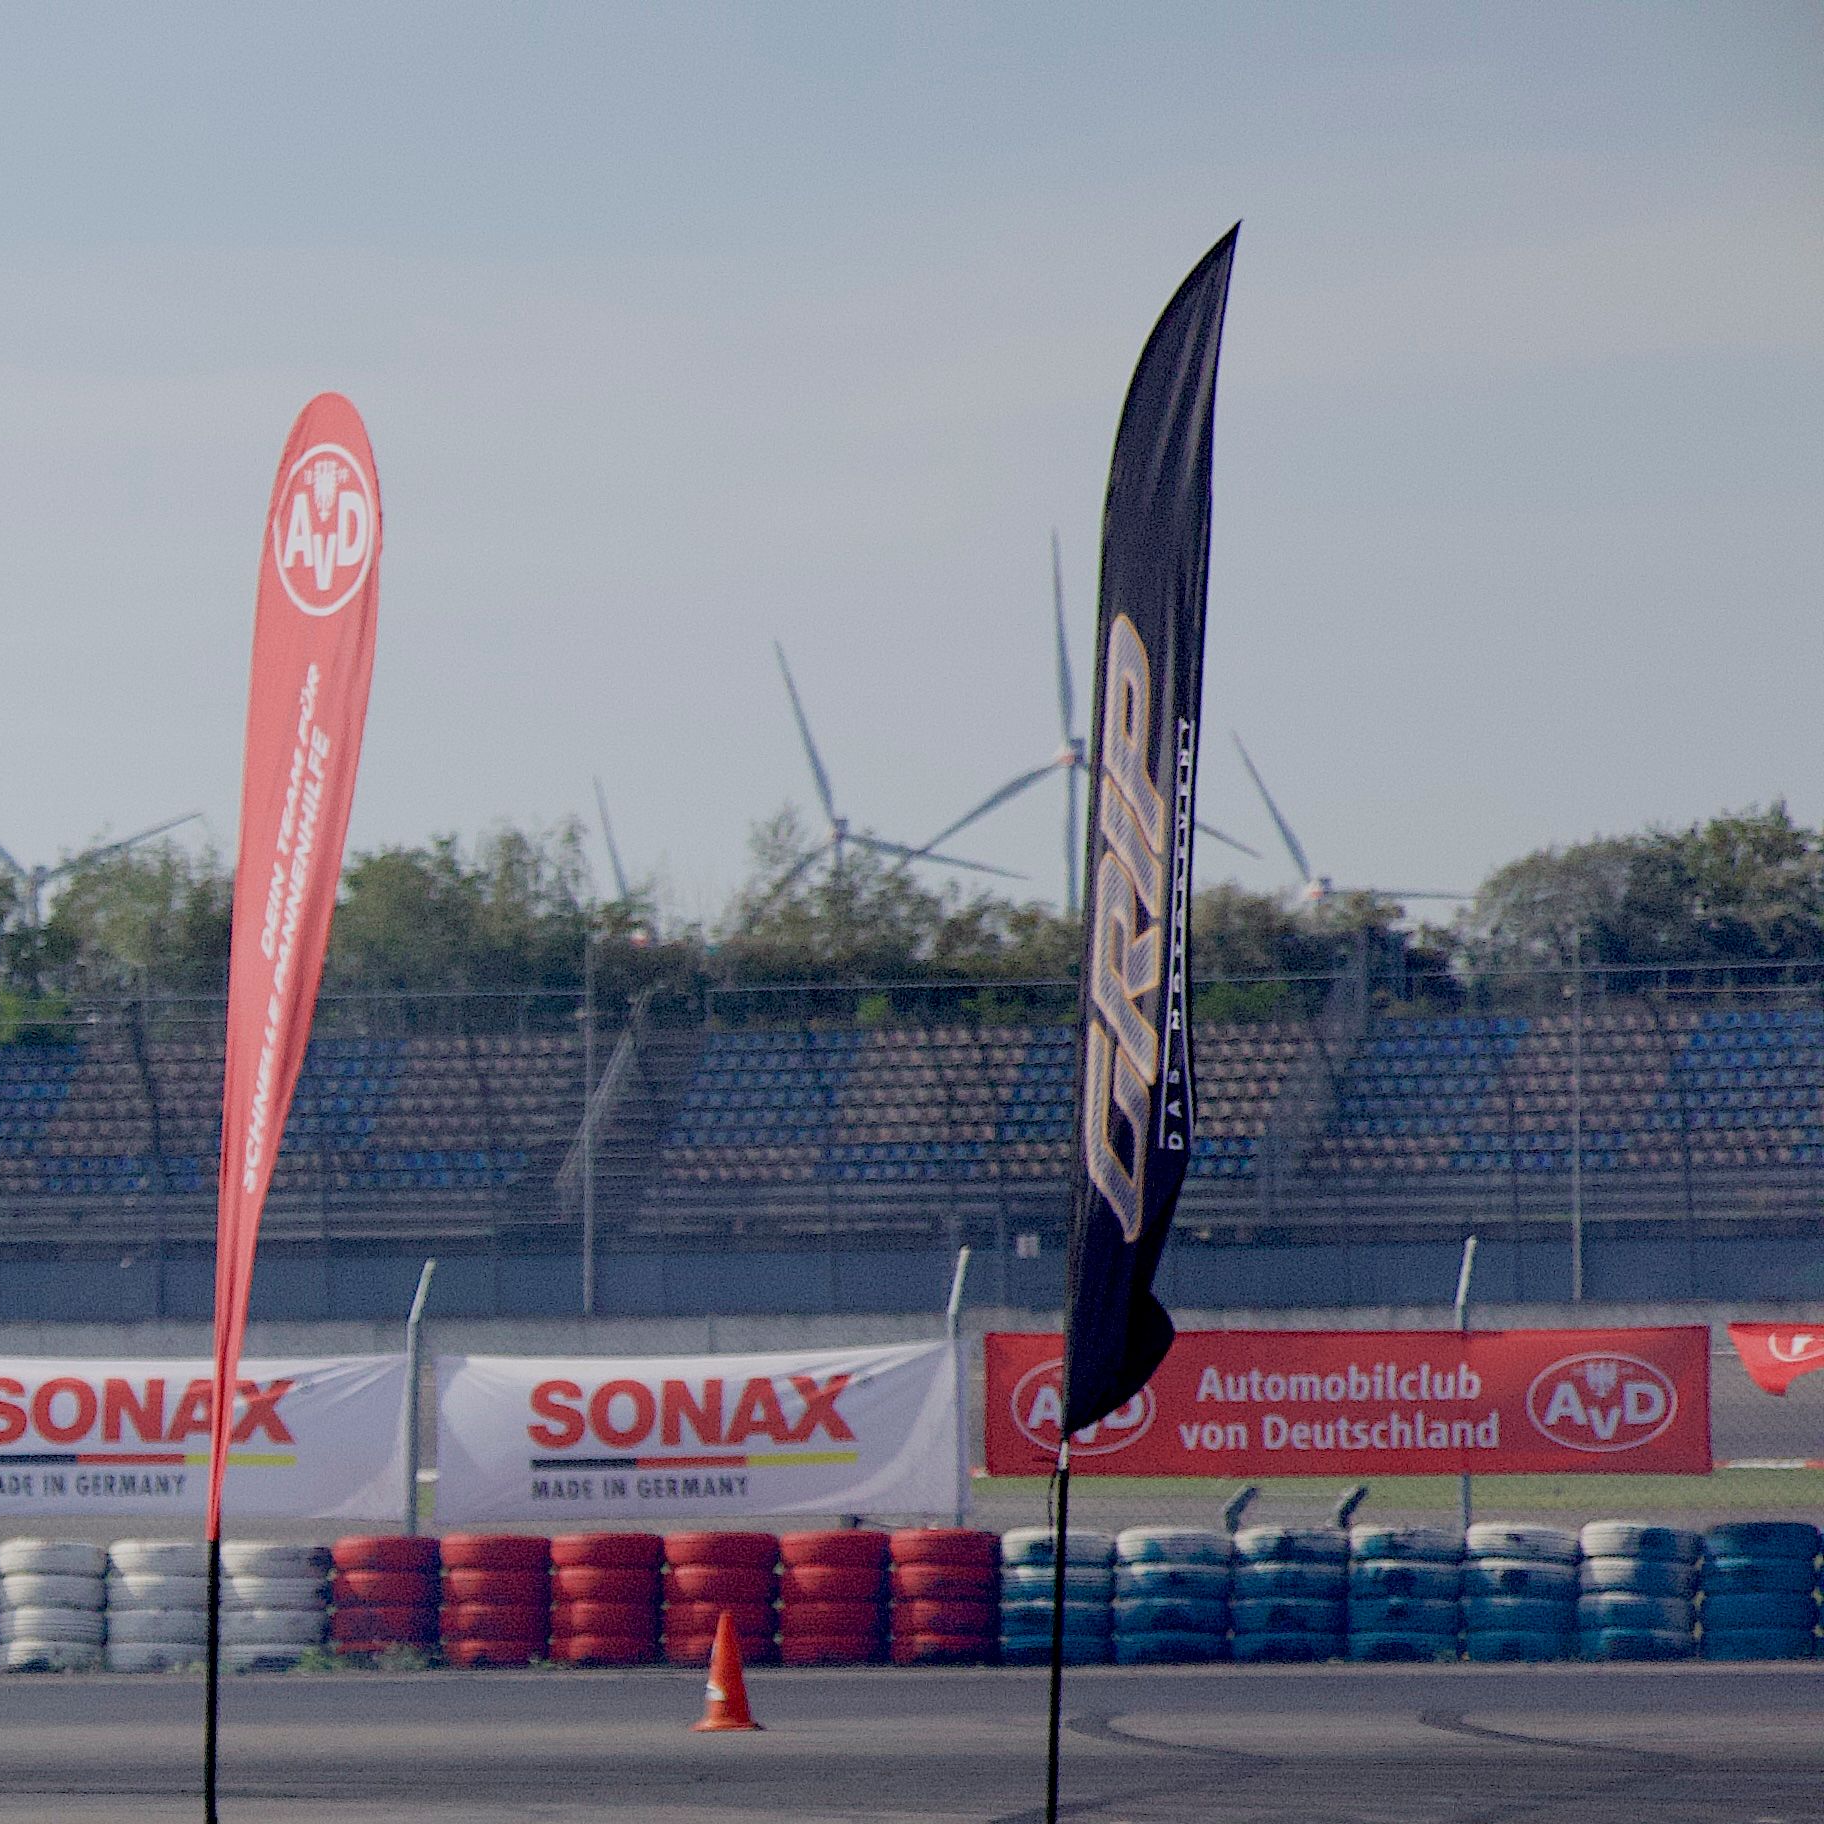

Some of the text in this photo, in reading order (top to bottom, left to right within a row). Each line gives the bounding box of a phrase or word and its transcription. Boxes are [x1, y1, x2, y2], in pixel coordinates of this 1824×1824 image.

[260, 661, 322, 961] DEIN TEAM FÜR
[273, 724, 332, 996] PANNENHILFE
[1195, 1361, 1483, 1402] Automobilclub
[526, 1373, 858, 1449] SONAX
[1026, 1384, 1145, 1444] AD
[1178, 1408, 1501, 1451] von Deutschland
[42, 1473, 66, 1497] IN
[76, 1473, 187, 1498] GERMANY
[530, 1476, 750, 1500] MADE IN GERMANY
